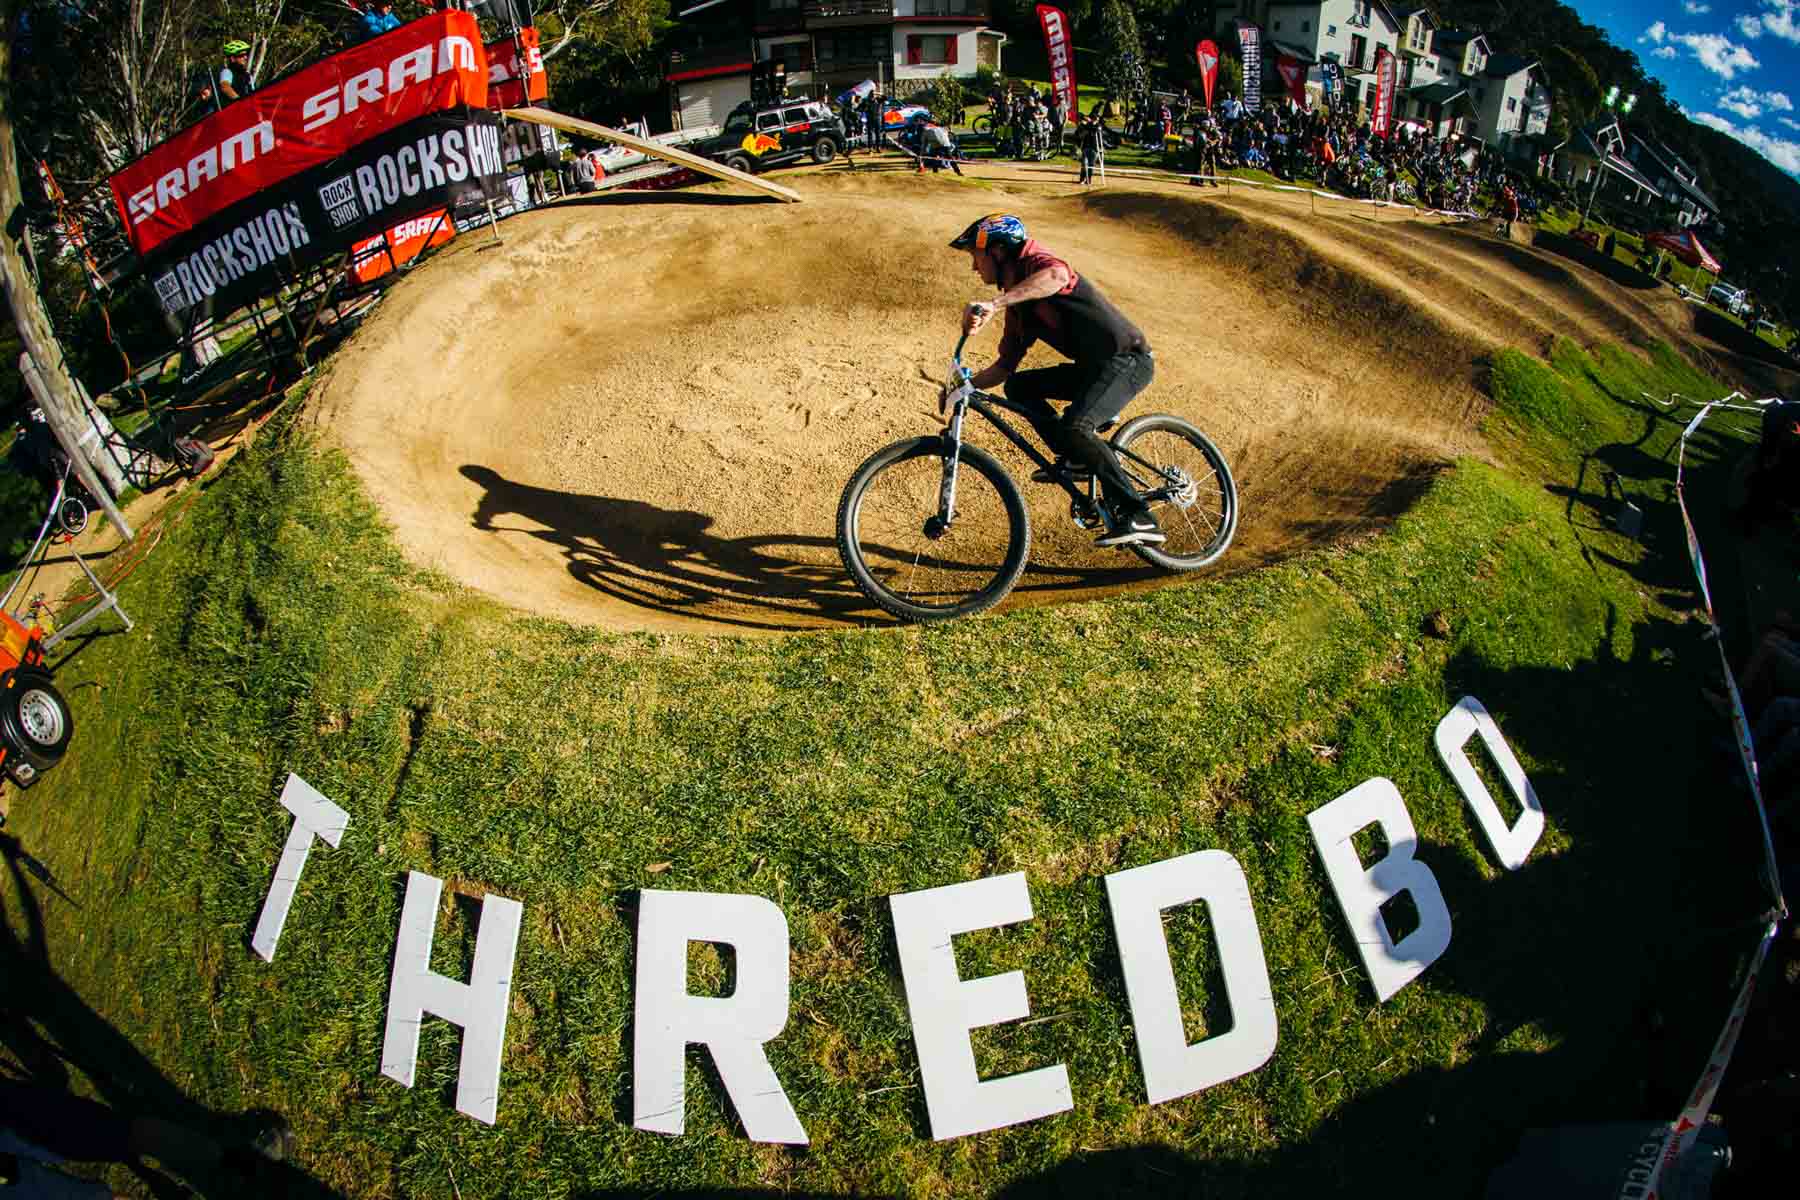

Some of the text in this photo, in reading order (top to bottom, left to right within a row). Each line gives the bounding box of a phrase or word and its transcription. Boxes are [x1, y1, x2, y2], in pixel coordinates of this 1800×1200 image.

[303, 36, 476, 133] SRAM
[128, 120, 276, 226] SRAM
[322, 177, 353, 208] ROCK
[330, 200, 360, 228] SHOX
[356, 125, 503, 215] ROCKSHOX
[176, 201, 311, 305] ROCKSHOX
[251, 695, 1546, 1146] THREDBO
